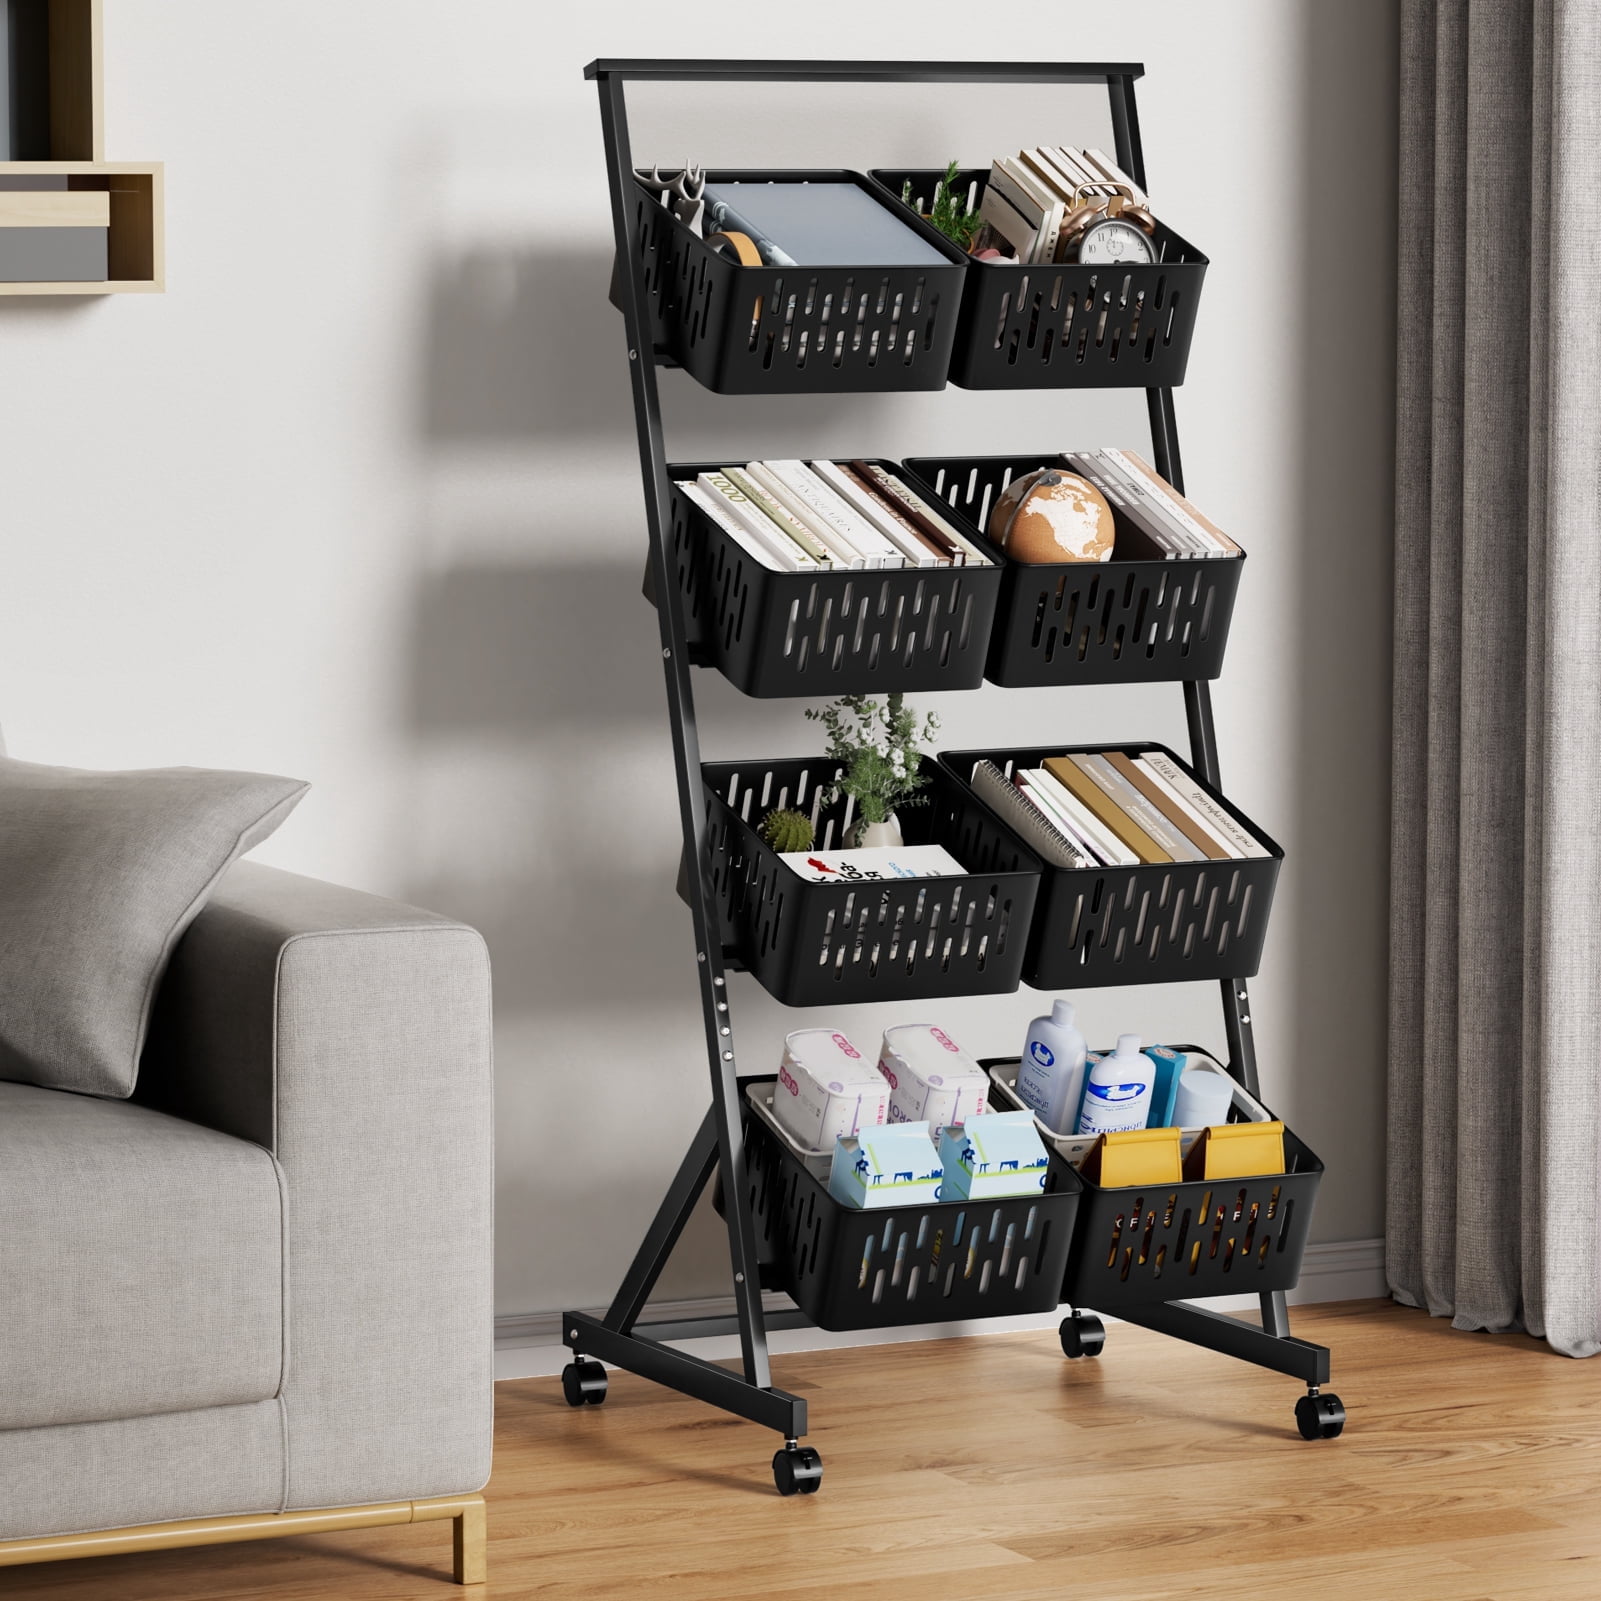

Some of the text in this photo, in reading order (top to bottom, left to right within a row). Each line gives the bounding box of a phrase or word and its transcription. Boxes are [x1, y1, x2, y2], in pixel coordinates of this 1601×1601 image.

[1097, 232, 1105, 242] 11
[1088, 244, 1096, 254] 10
[1137, 241, 1144, 251] 2
[705, 475, 748, 503] 1000
